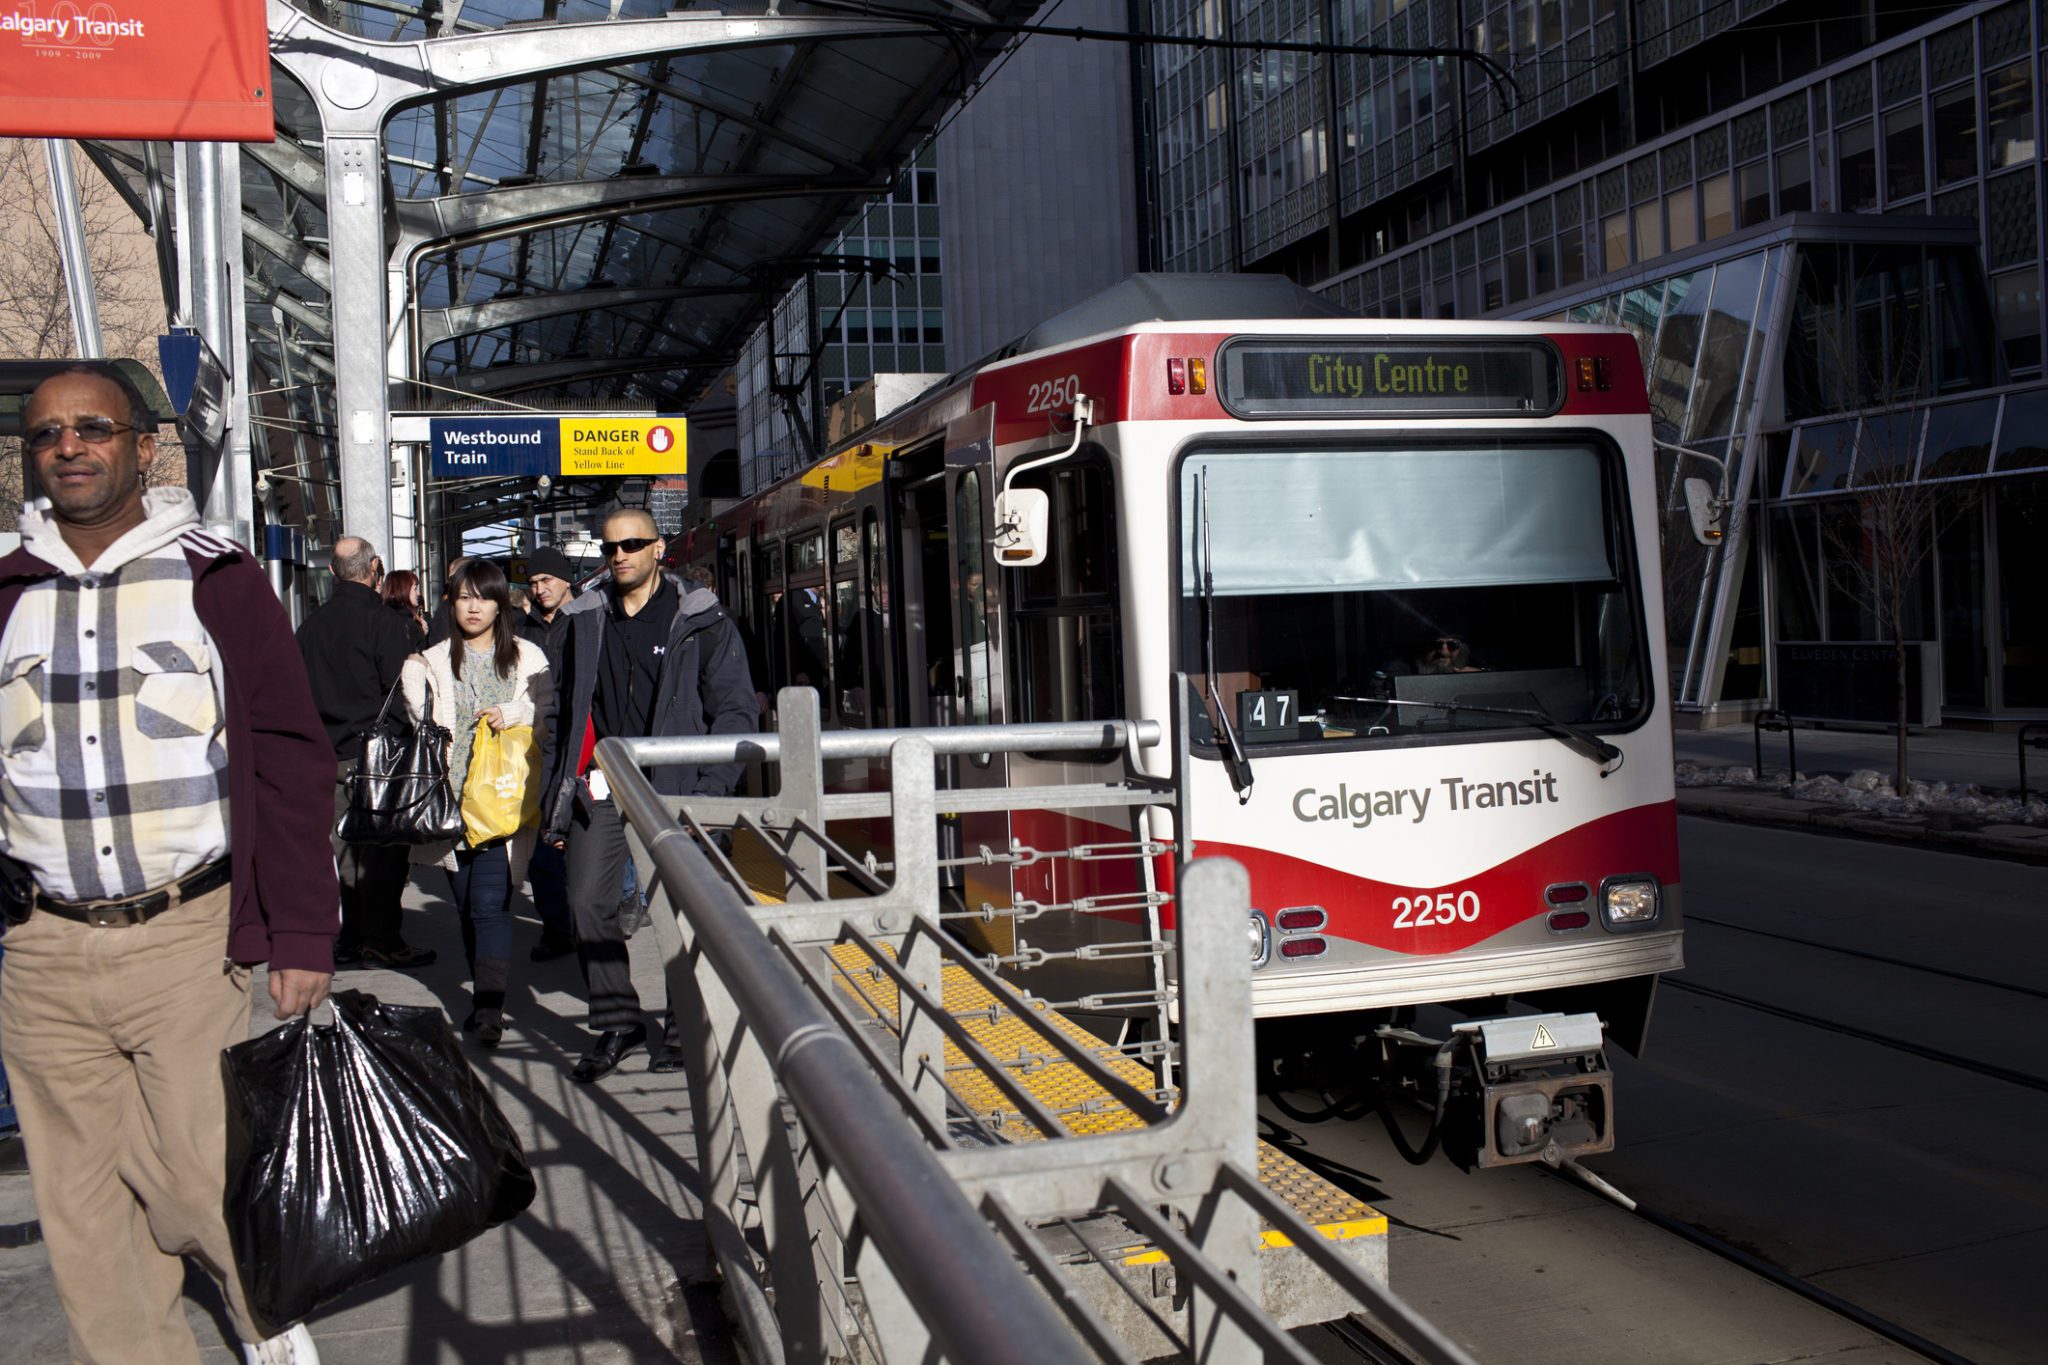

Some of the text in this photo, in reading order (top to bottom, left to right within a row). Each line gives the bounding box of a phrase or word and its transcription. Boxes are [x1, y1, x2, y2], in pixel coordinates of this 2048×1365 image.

[0, 11, 144, 38] algary Transit
[35, 49, 61, 57] 1909
[75, 51, 101, 59] 2009
[1308, 353, 1469, 398] City Centre
[1026, 374, 1080, 413] 2250
[444, 430, 542, 445] Westbound
[573, 430, 639, 442] DANGER
[444, 451, 488, 465] Train
[573, 446, 635, 457] Stand Back of
[573, 460, 625, 469] Yellow Line
[1852, 648, 1898, 661] CENTR
[1292, 769, 1558, 828] Calgary Transit
[1391, 890, 1480, 928] 2250
